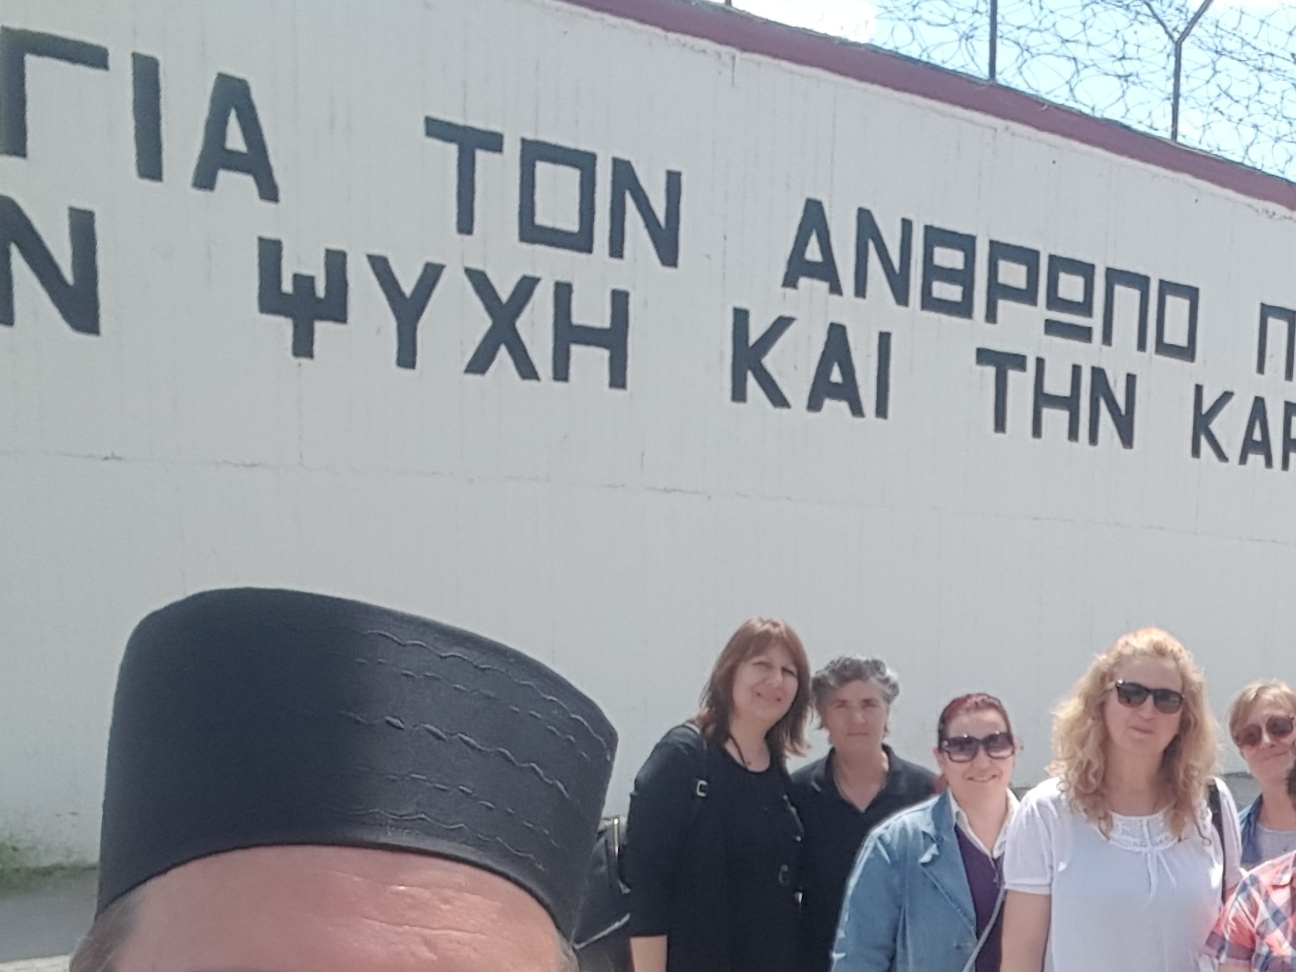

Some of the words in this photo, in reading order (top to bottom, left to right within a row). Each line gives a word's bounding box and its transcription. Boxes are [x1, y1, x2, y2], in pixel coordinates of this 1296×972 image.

[0, 25, 279, 204] ΓΙΑ
[424, 115, 682, 269] ΤΟΝ
[782, 197, 1200, 363] ΑΝΘΡΩΠΟ
[257, 236, 630, 390] ΨΥΧΗ
[730, 306, 892, 420] ΚΑΙ
[975, 347, 1137, 450] ΤΗΝ
